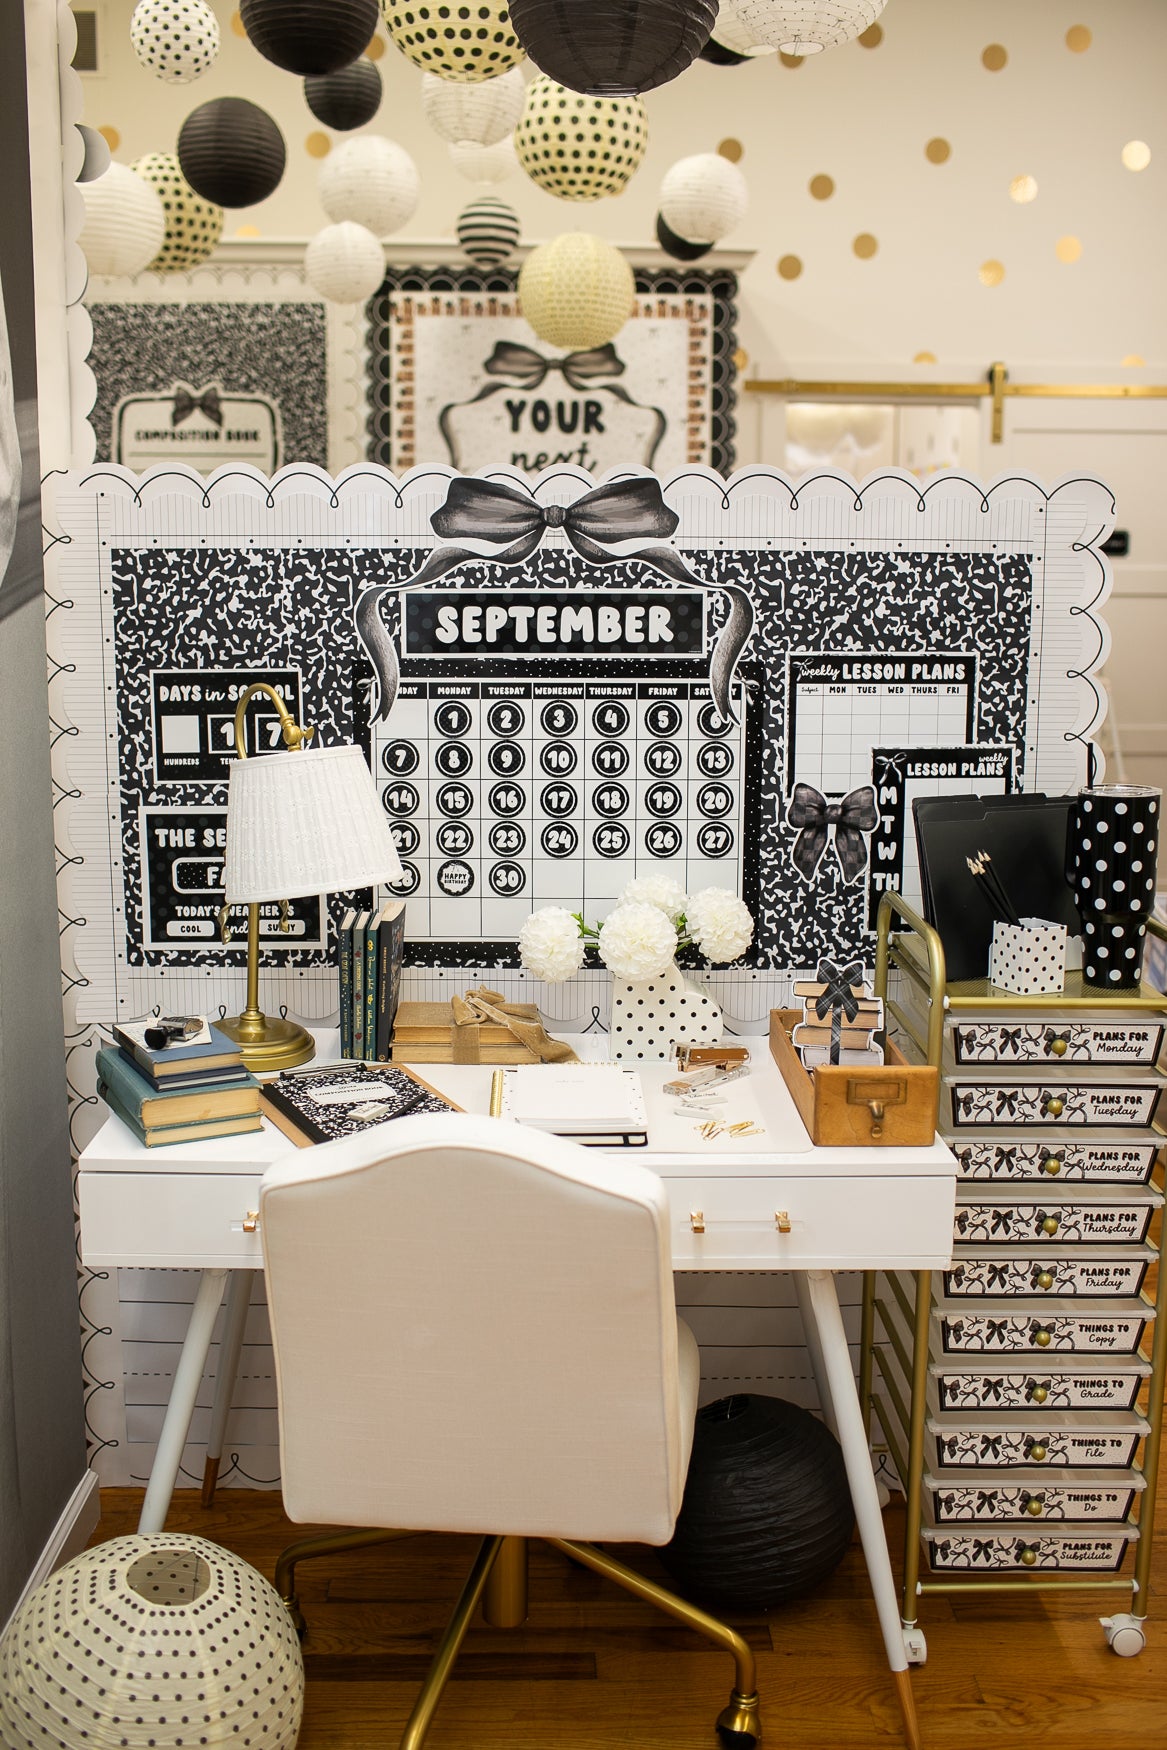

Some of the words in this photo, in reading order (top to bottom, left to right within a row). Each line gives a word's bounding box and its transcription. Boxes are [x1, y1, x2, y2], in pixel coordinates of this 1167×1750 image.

[505, 400, 605, 434] YOUR
[135, 429, 220, 442] COMPOSITION
[226, 429, 261, 442] BOOK
[510, 441, 598, 472] next
[435, 606, 675, 643] SEPTEMBER
[801, 664, 841, 681] weekly
[842, 663, 906, 680] LESSON
[911, 663, 966, 680] PLANS
[159, 685, 202, 702] DAYS
[205, 686, 226, 702] in
[437, 686, 472, 695] MONDAY
[488, 686, 525, 695] TUESDAY
[534, 686, 583, 695] WEDNESDAY
[589, 687, 633, 695] THURSDAY
[648, 687, 678, 695] FRIDAY
[829, 686, 847, 694] MON
[857, 686, 877, 694] TUES
[887, 686, 904, 694] WED
[911, 686, 938, 694] THURS
[946, 686, 960, 694] FRI
[448, 711, 458, 728] 1
[501, 710, 511, 728] 2
[554, 709, 565, 727] 3
[605, 710, 617, 727] 4
[658, 711, 668, 728] 5
[710, 711, 721, 729] 6
[220, 721, 235, 747] 1
[266, 721, 282, 747] 7
[163, 757, 200, 766] HUNDREDS
[395, 750, 406, 767] 7
[449, 750, 460, 768] 8
[501, 750, 512, 767] 9
[548, 751, 569, 768] 10
[601, 751, 620, 768] 11
[652, 751, 673, 768] 12
[705, 751, 726, 768] 13
[979, 752, 1009, 766] weekly
[906, 763, 957, 776] LESSON
[961, 762, 1004, 776] PLANS
[389, 790, 412, 808] 14
[444, 791, 465, 808] 15
[497, 791, 518, 809] 16
[548, 791, 570, 808] 17
[600, 791, 621, 808] 18
[653, 792, 674, 808] 19
[704, 792, 726, 809] 20
[879, 786, 898, 805] M
[881, 815, 895, 834] T
[154, 828, 196, 848] THE
[393, 829, 412, 847] 21
[444, 830, 466, 847] 22
[496, 830, 518, 848] 23
[548, 831, 571, 848] 24
[601, 831, 622, 848] 25
[653, 831, 674, 848] 26
[705, 831, 726, 848] 27
[877, 841, 897, 861] W
[444, 872, 467, 880] HAPPY
[496, 870, 518, 887] 30
[872, 872, 900, 891] TH
[175, 905, 221, 917] TODAY'S
[180, 925, 202, 933] COOL
[1093, 1031, 1126, 1041] PLANS
[1129, 1031, 1149, 1041] FOR
[1096, 1042, 1144, 1057] Monday
[1090, 1095, 1121, 1104] PLANS
[1124, 1095, 1143, 1104] FOR
[1093, 1105, 1138, 1119] Tuesday
[1088, 1151, 1119, 1161] PLANS
[1121, 1152, 1140, 1161] FOR
[1083, 1162, 1145, 1176] Wednesday
[1083, 1213, 1115, 1222] PLANS
[1118, 1213, 1138, 1222] FOR
[1083, 1222, 1137, 1236] Thursday
[1080, 1267, 1110, 1276] PLANS
[1113, 1268, 1131, 1276] FOR
[1085, 1277, 1123, 1290] Friday
[1079, 1324, 1114, 1332] THINGS
[1117, 1324, 1129, 1332] TO
[1089, 1333, 1117, 1346] Copy
[1073, 1380, 1109, 1388] THINGS
[1111, 1380, 1124, 1388] TO
[1080, 1389, 1115, 1398] Grade
[1071, 1439, 1107, 1447] THINGS
[1109, 1439, 1122, 1447] TO
[1085, 1448, 1106, 1457] File
[1084, 1502, 1098, 1512] Do
[1062, 1542, 1092, 1550] PLANS
[1094, 1542, 1112, 1550] FOR
[1060, 1551, 1112, 1560] Substitute
